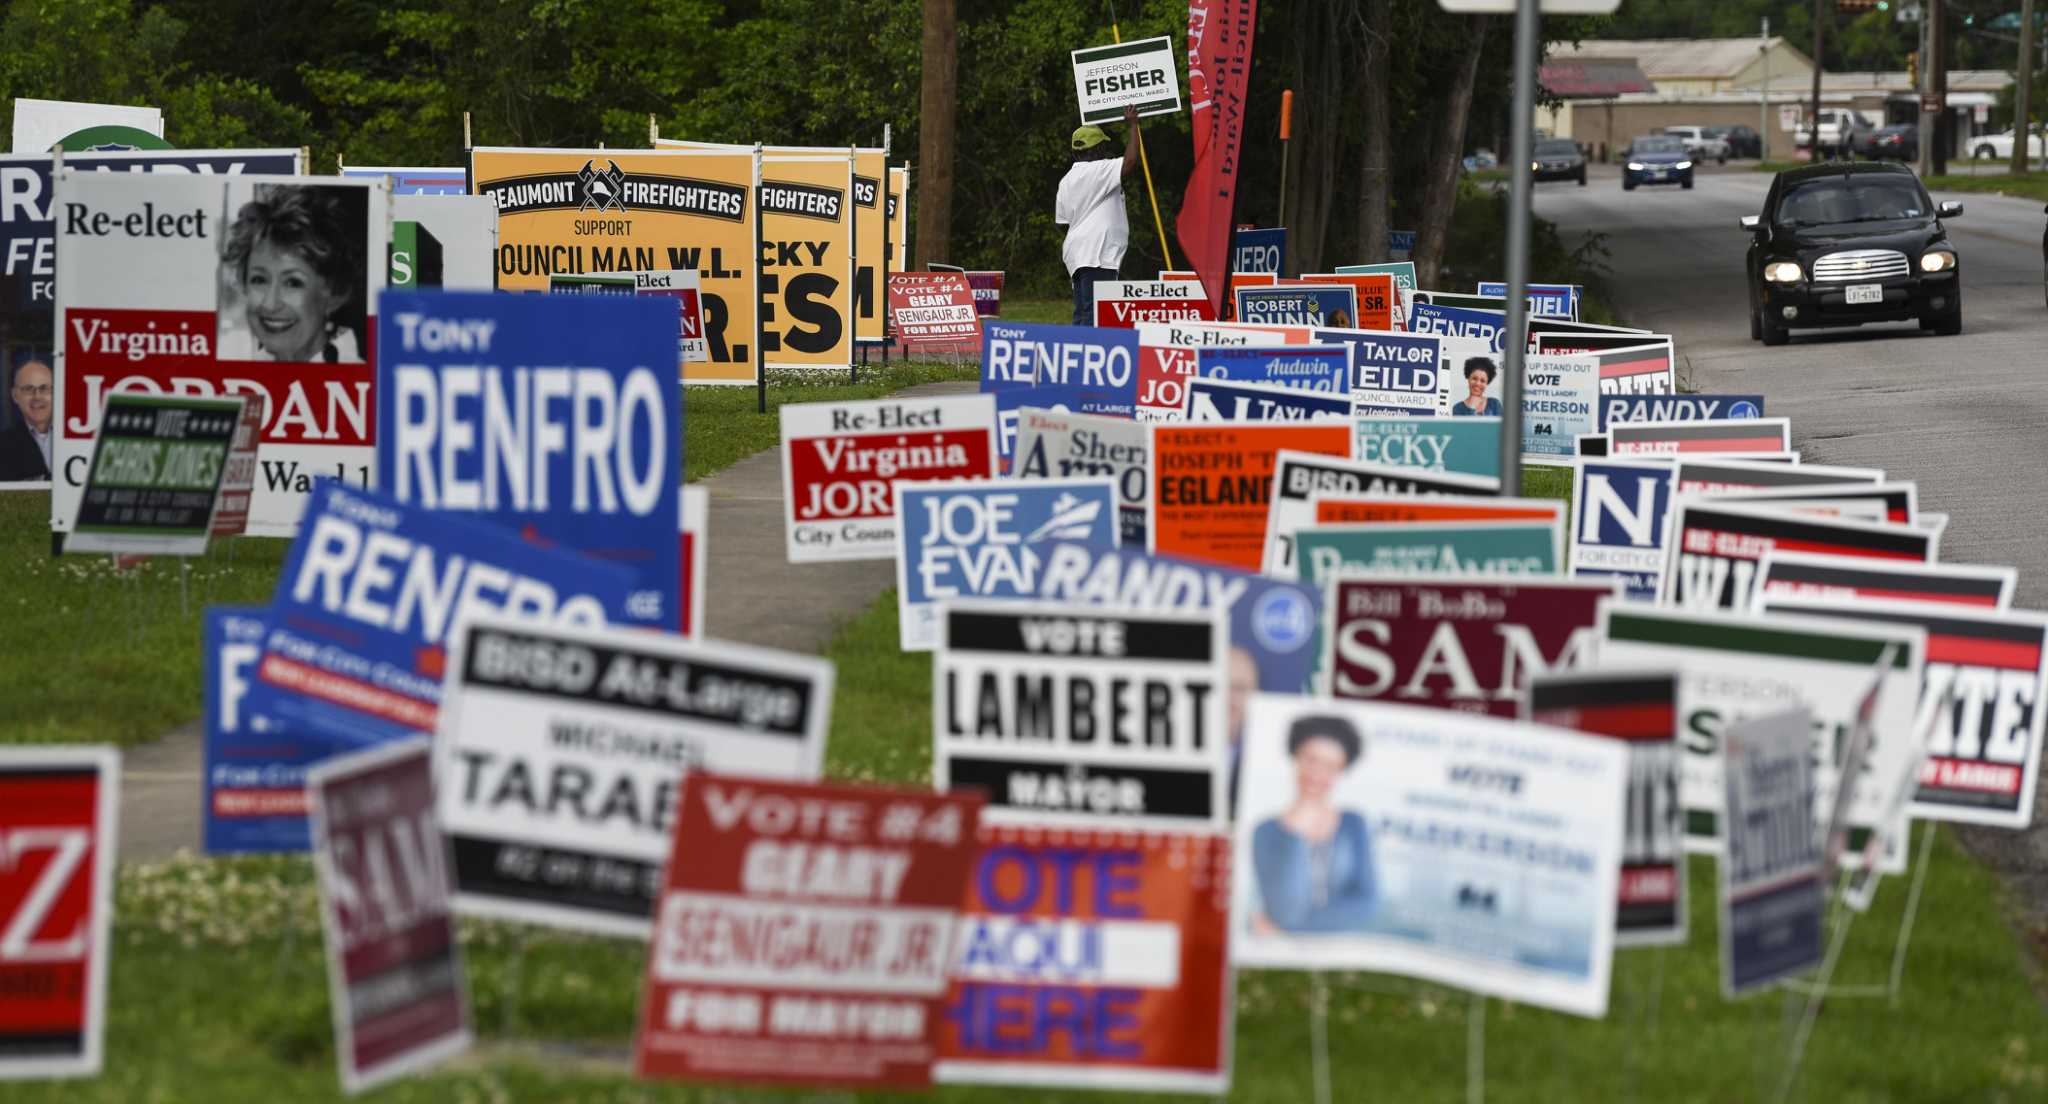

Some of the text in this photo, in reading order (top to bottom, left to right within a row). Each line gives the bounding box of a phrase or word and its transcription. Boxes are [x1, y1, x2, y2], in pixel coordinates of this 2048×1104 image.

[1086, 62, 1138, 77] JEFFERSON
[1084, 69, 1166, 96] FISHER
[623, 182, 742, 215] FIREFIGHTERS
[761, 187, 838, 216] FIGHTERS
[64, 201, 208, 238] Re-elect
[574, 219, 633, 237] SUPPORT
[498, 244, 742, 279] OUNCILMAN W.L.
[636, 274, 672, 288] Elect
[891, 284, 965, 296] VOTE #4
[1123, 284, 1188, 299] Re-Elect
[908, 294, 953, 307] GEARY
[1246, 299, 1303, 313] ROBERT
[899, 307, 974, 323] SENIGAUR JR.
[1111, 302, 1203, 324] Virginia
[1418, 307, 1442, 318] TONY
[393, 311, 496, 353] TONY
[903, 323, 976, 335] FOR MAYOR
[991, 326, 1027, 339] TONY
[72, 319, 210, 361] Virginia
[1362, 341, 1434, 363] TAYLOR
[988, 339, 1132, 388] RENFRO
[1264, 357, 1331, 378] Audwin
[1529, 362, 1541, 370] UP
[1543, 362, 1572, 373] STAND
[1573, 364, 1592, 373] OUT
[1528, 374, 1561, 386] VOTE
[1081, 403, 1132, 414] AT LARGE
[1396, 395, 1428, 405] WARD
[1605, 398, 1721, 423] RANDY
[831, 405, 942, 431] Re-Elect
[1534, 423, 1552, 436] #4
[395, 365, 668, 518] RENFRO
[812, 433, 969, 477] Virginia
[1160, 451, 1243, 469] JOSEPH
[921, 494, 1021, 547] JOE
[794, 527, 834, 546] City
[1018, 617, 1128, 657] VOTE
[946, 669, 1215, 751] LAMBERT
[701, 787, 868, 843] VOTE
